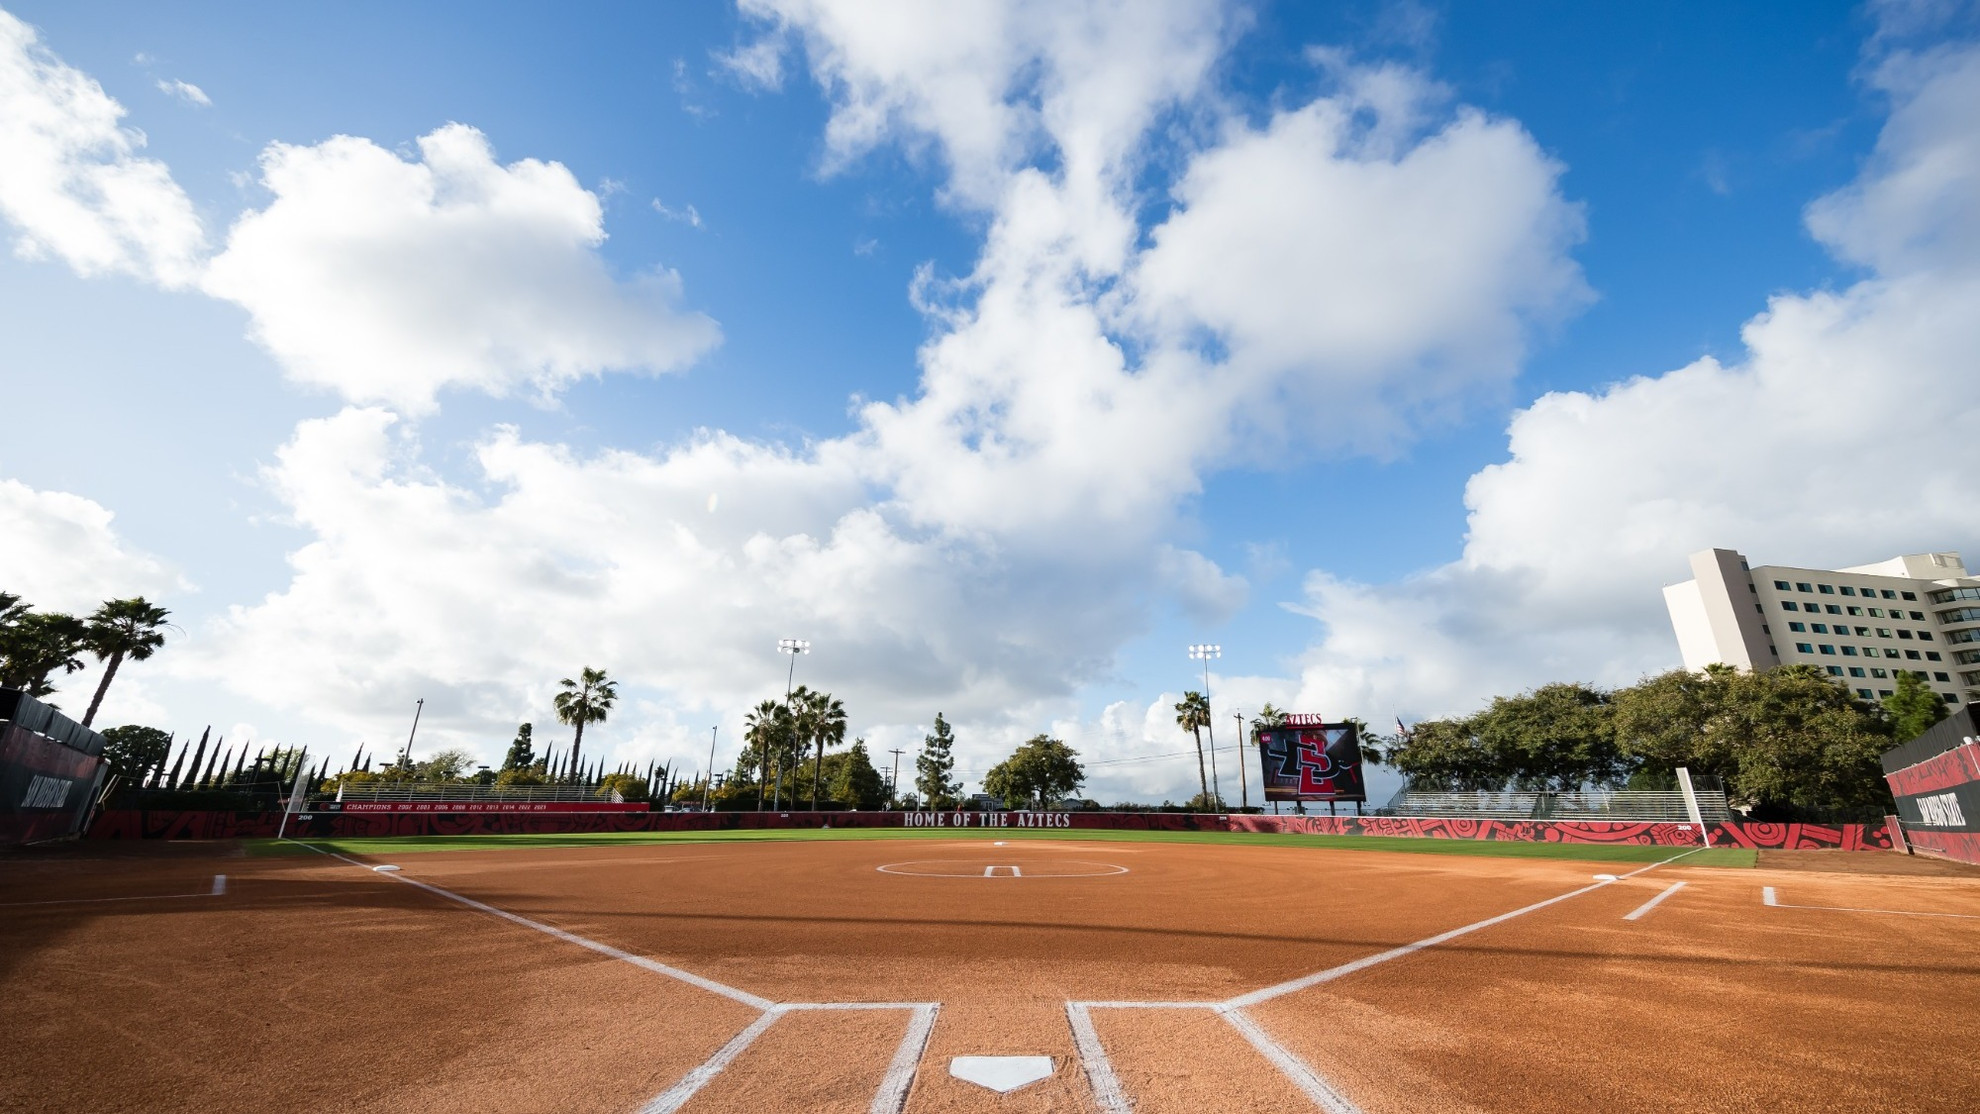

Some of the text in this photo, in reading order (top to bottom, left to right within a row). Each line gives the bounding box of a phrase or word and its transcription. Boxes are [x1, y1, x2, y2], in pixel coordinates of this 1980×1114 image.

[1286, 713, 1322, 724] AZTECS
[904, 812, 1070, 828] HOME OF THE AZTECS
